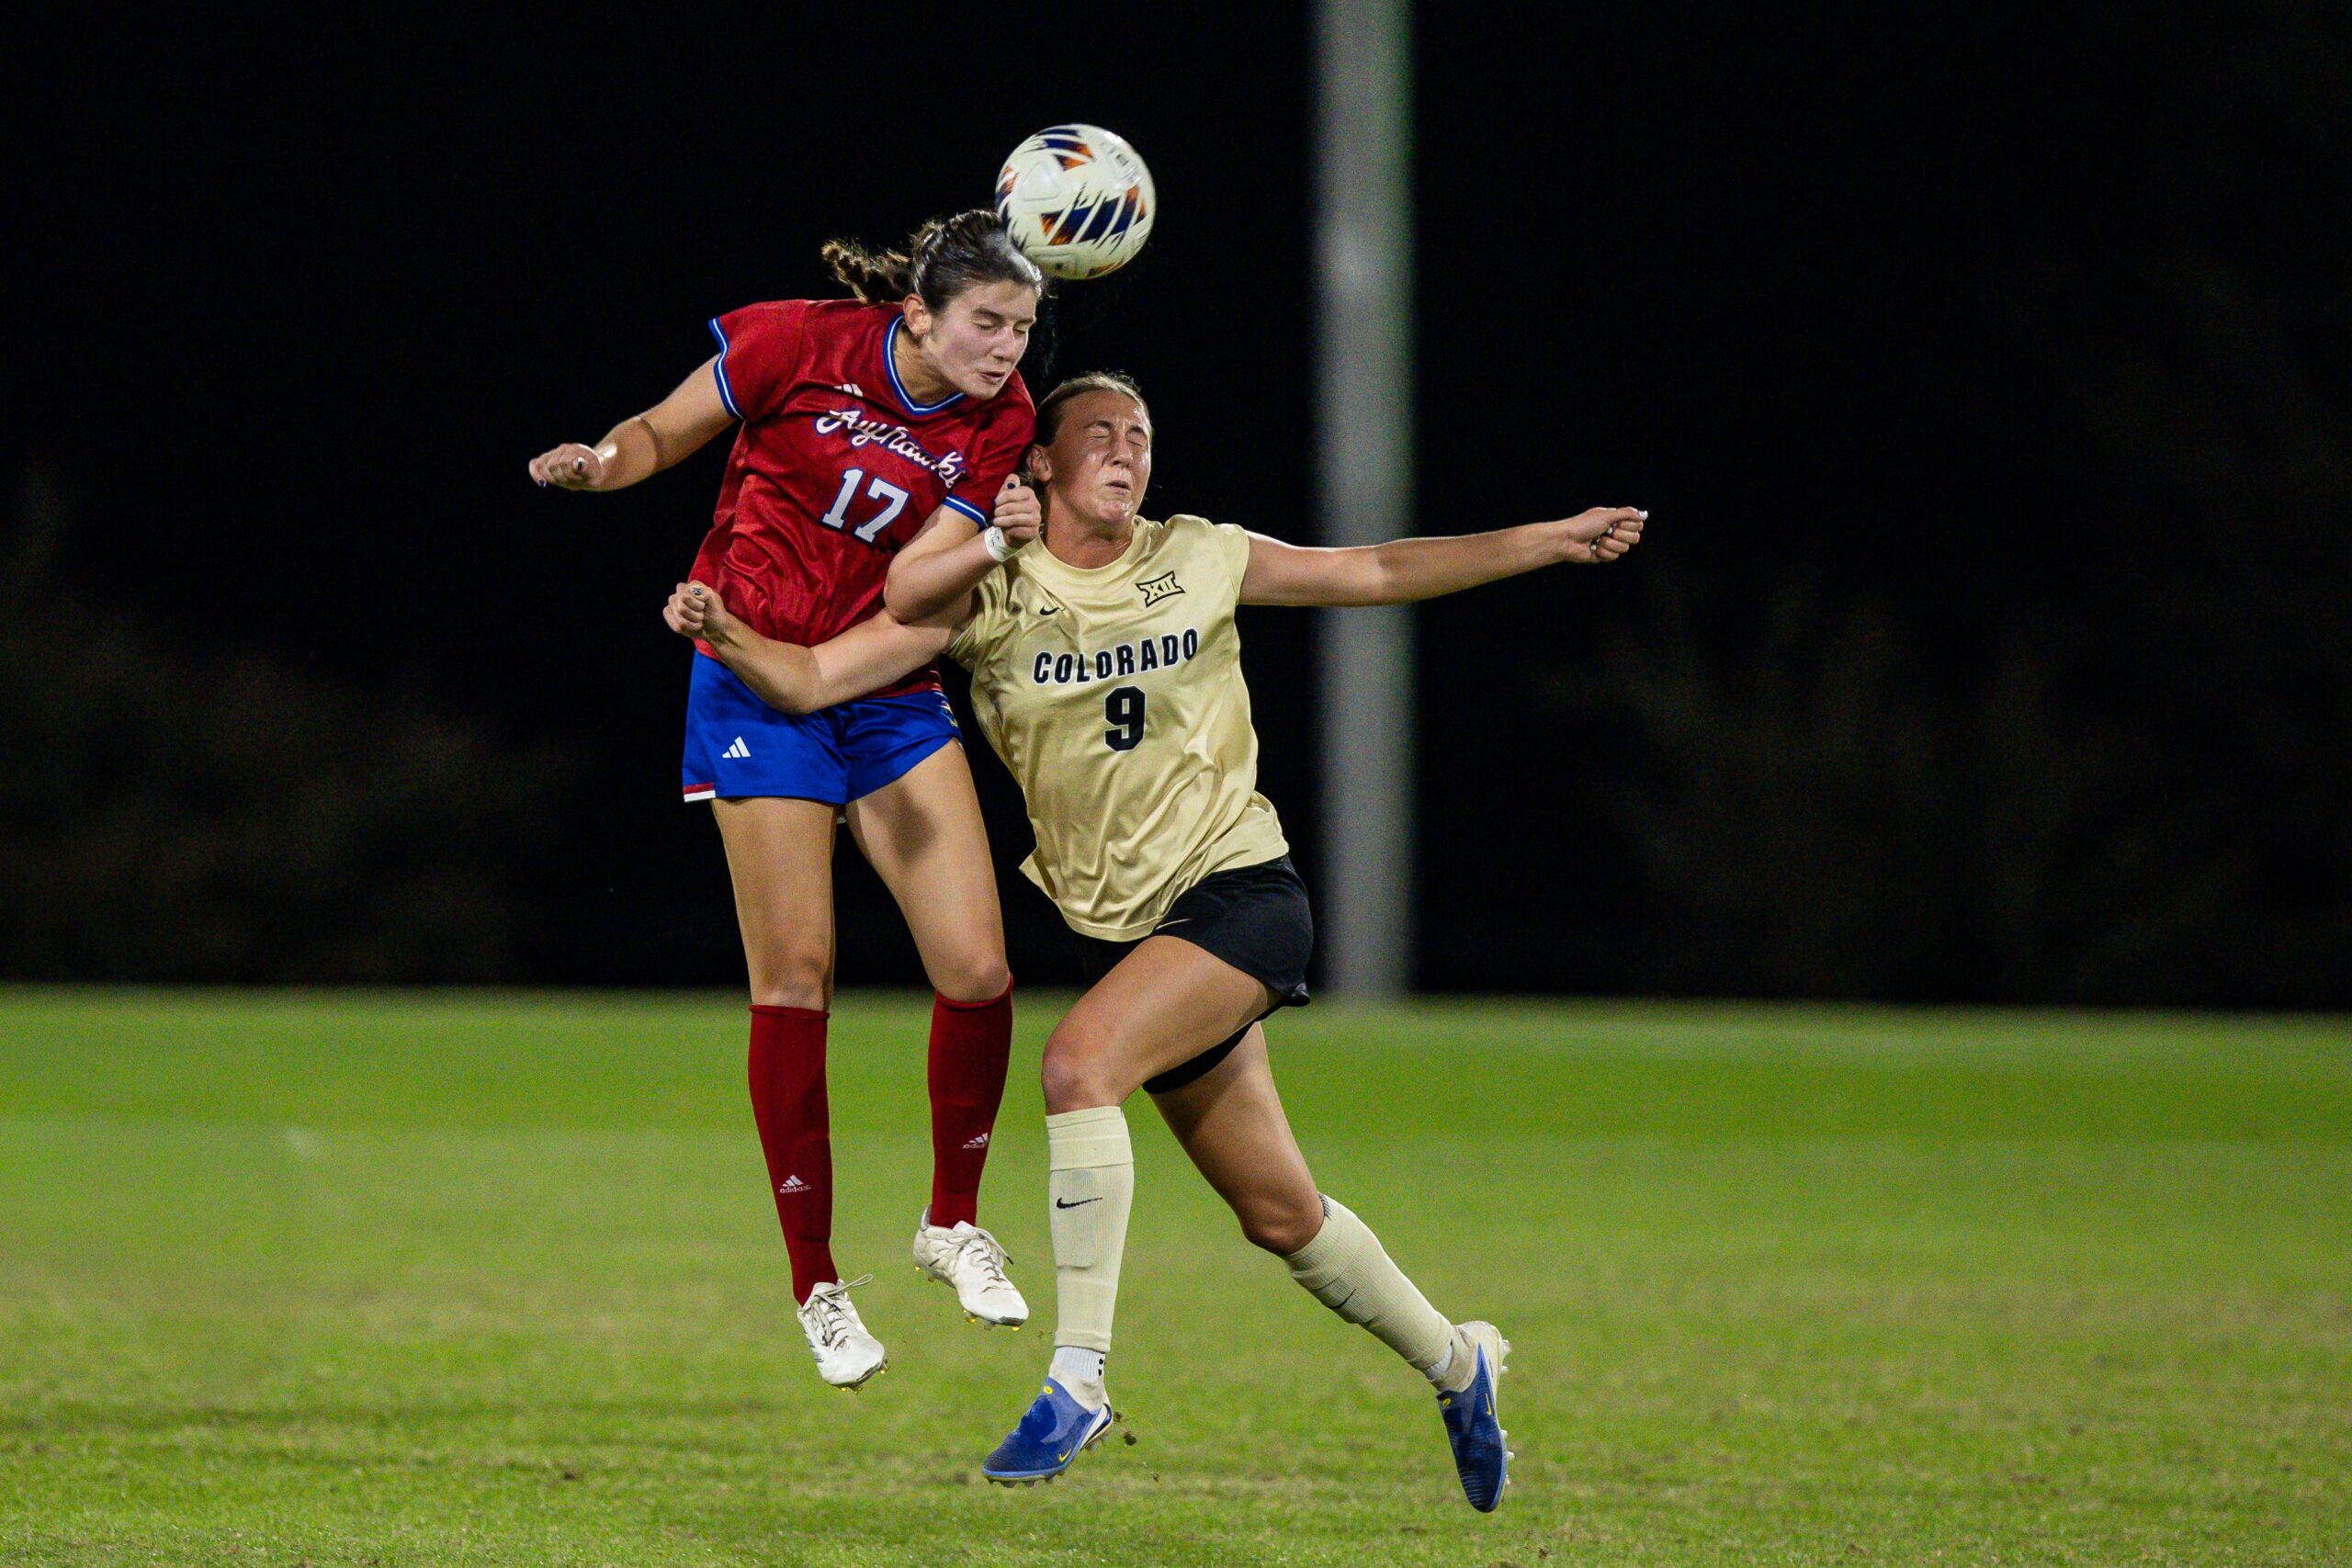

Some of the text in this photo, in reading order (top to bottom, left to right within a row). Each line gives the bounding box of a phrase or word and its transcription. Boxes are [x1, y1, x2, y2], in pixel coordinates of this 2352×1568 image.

[820, 467, 910, 544] 17
[1033, 628, 1200, 685] COLORADO
[1104, 685, 1147, 753] 9
[779, 1185, 809, 1194] adidas
